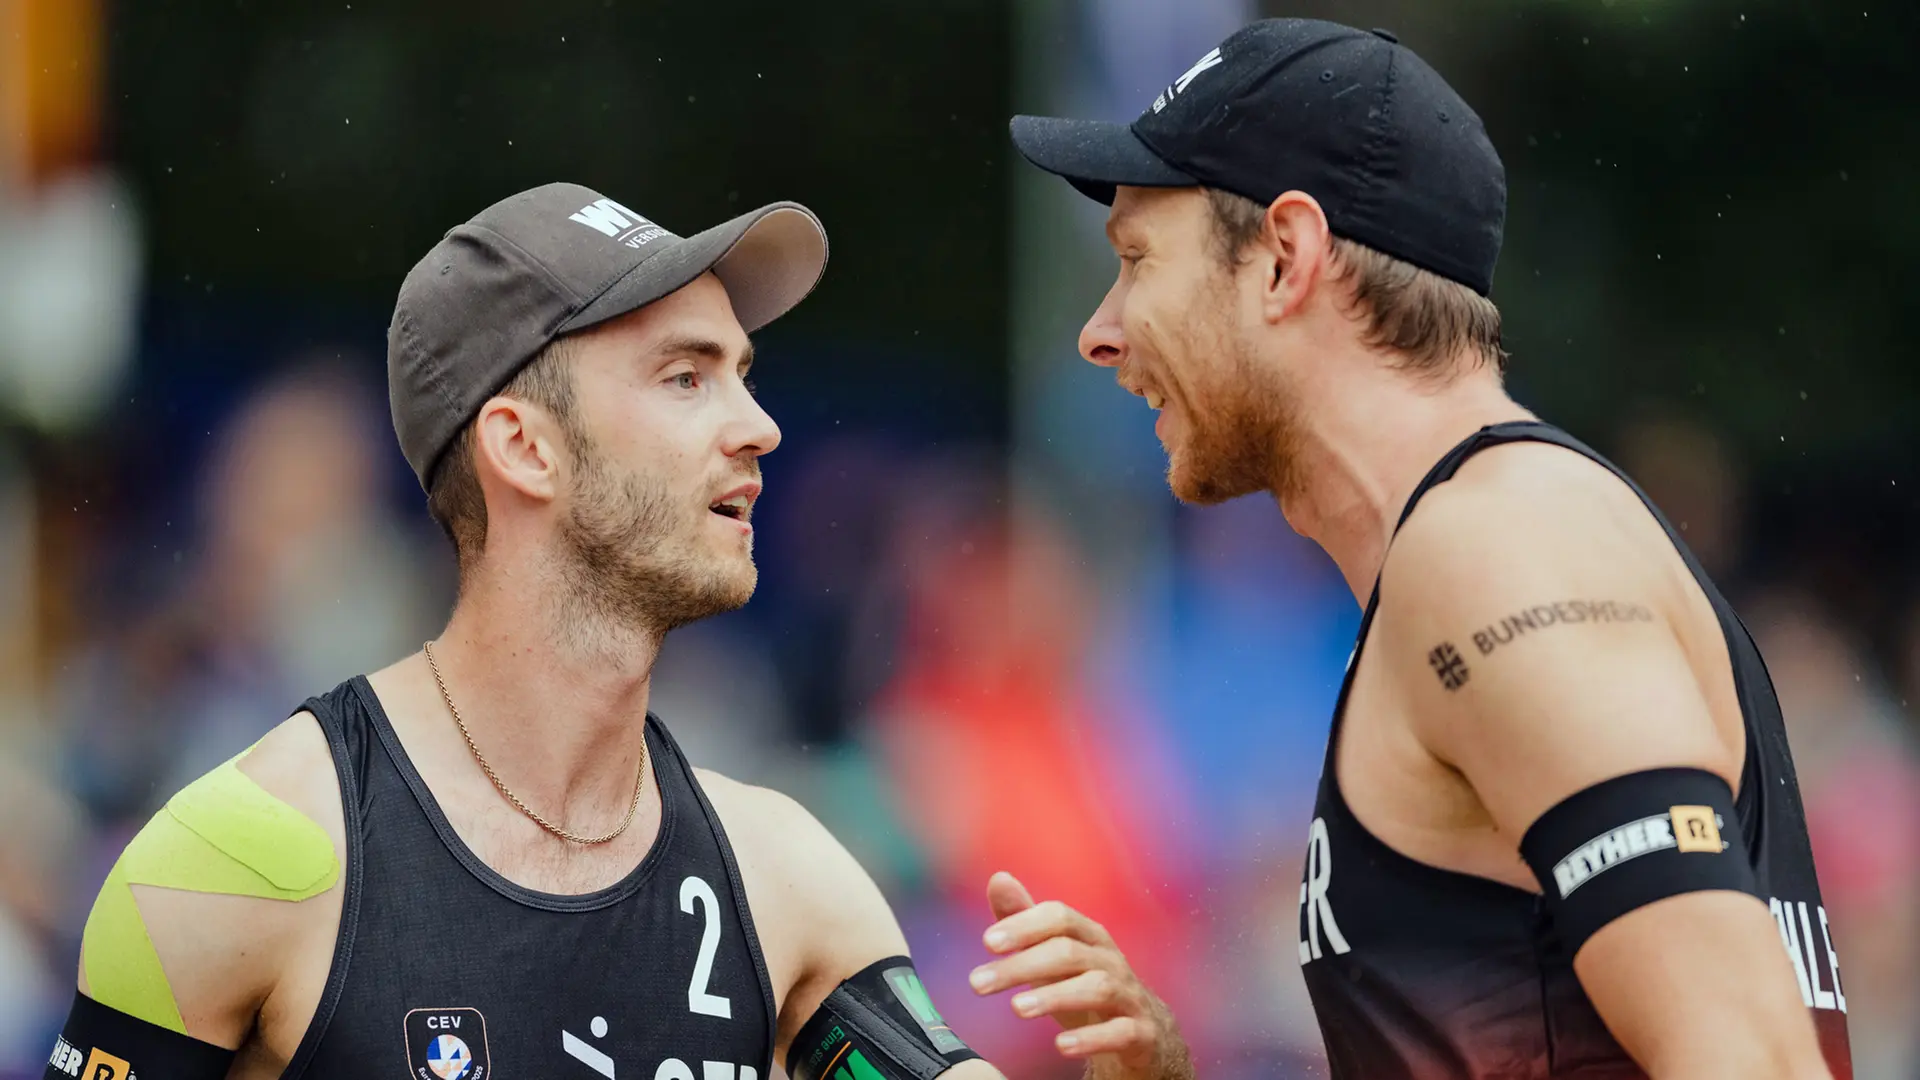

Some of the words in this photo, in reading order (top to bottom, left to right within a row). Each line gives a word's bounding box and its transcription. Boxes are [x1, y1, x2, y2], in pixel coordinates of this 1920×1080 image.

[1552, 815, 1678, 899] REYHER
[679, 875, 732, 1020] 2
[426, 1015, 462, 1030] CEV
